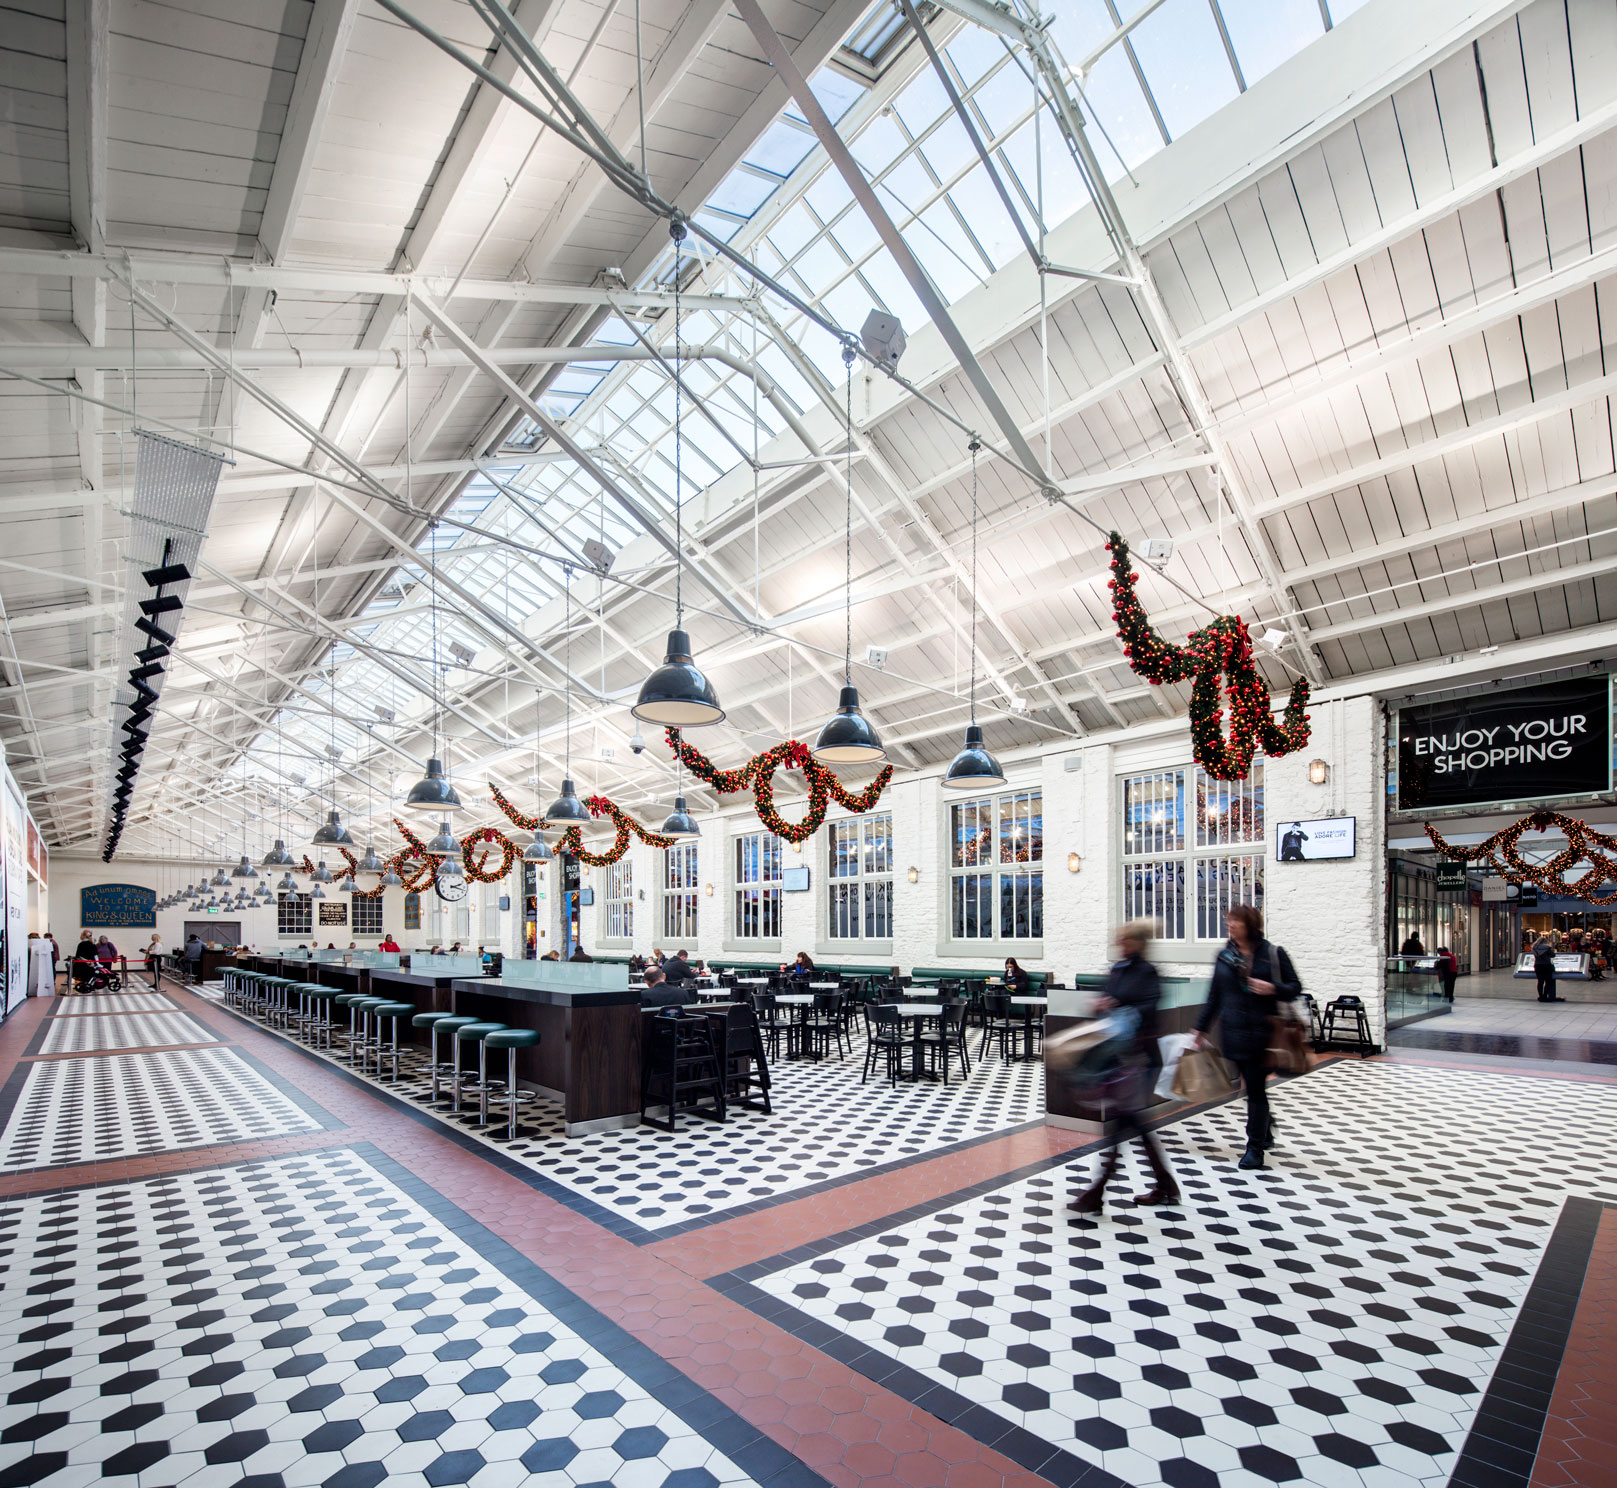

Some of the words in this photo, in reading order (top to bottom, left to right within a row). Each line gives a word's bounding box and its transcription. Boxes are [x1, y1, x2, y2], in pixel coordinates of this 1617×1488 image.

[1415, 726, 1500, 755] ENJOY
[1507, 714, 1587, 742] YOUR
[1434, 740, 1573, 774] SHOPPING
[1437, 869, 1466, 882] chapelle
